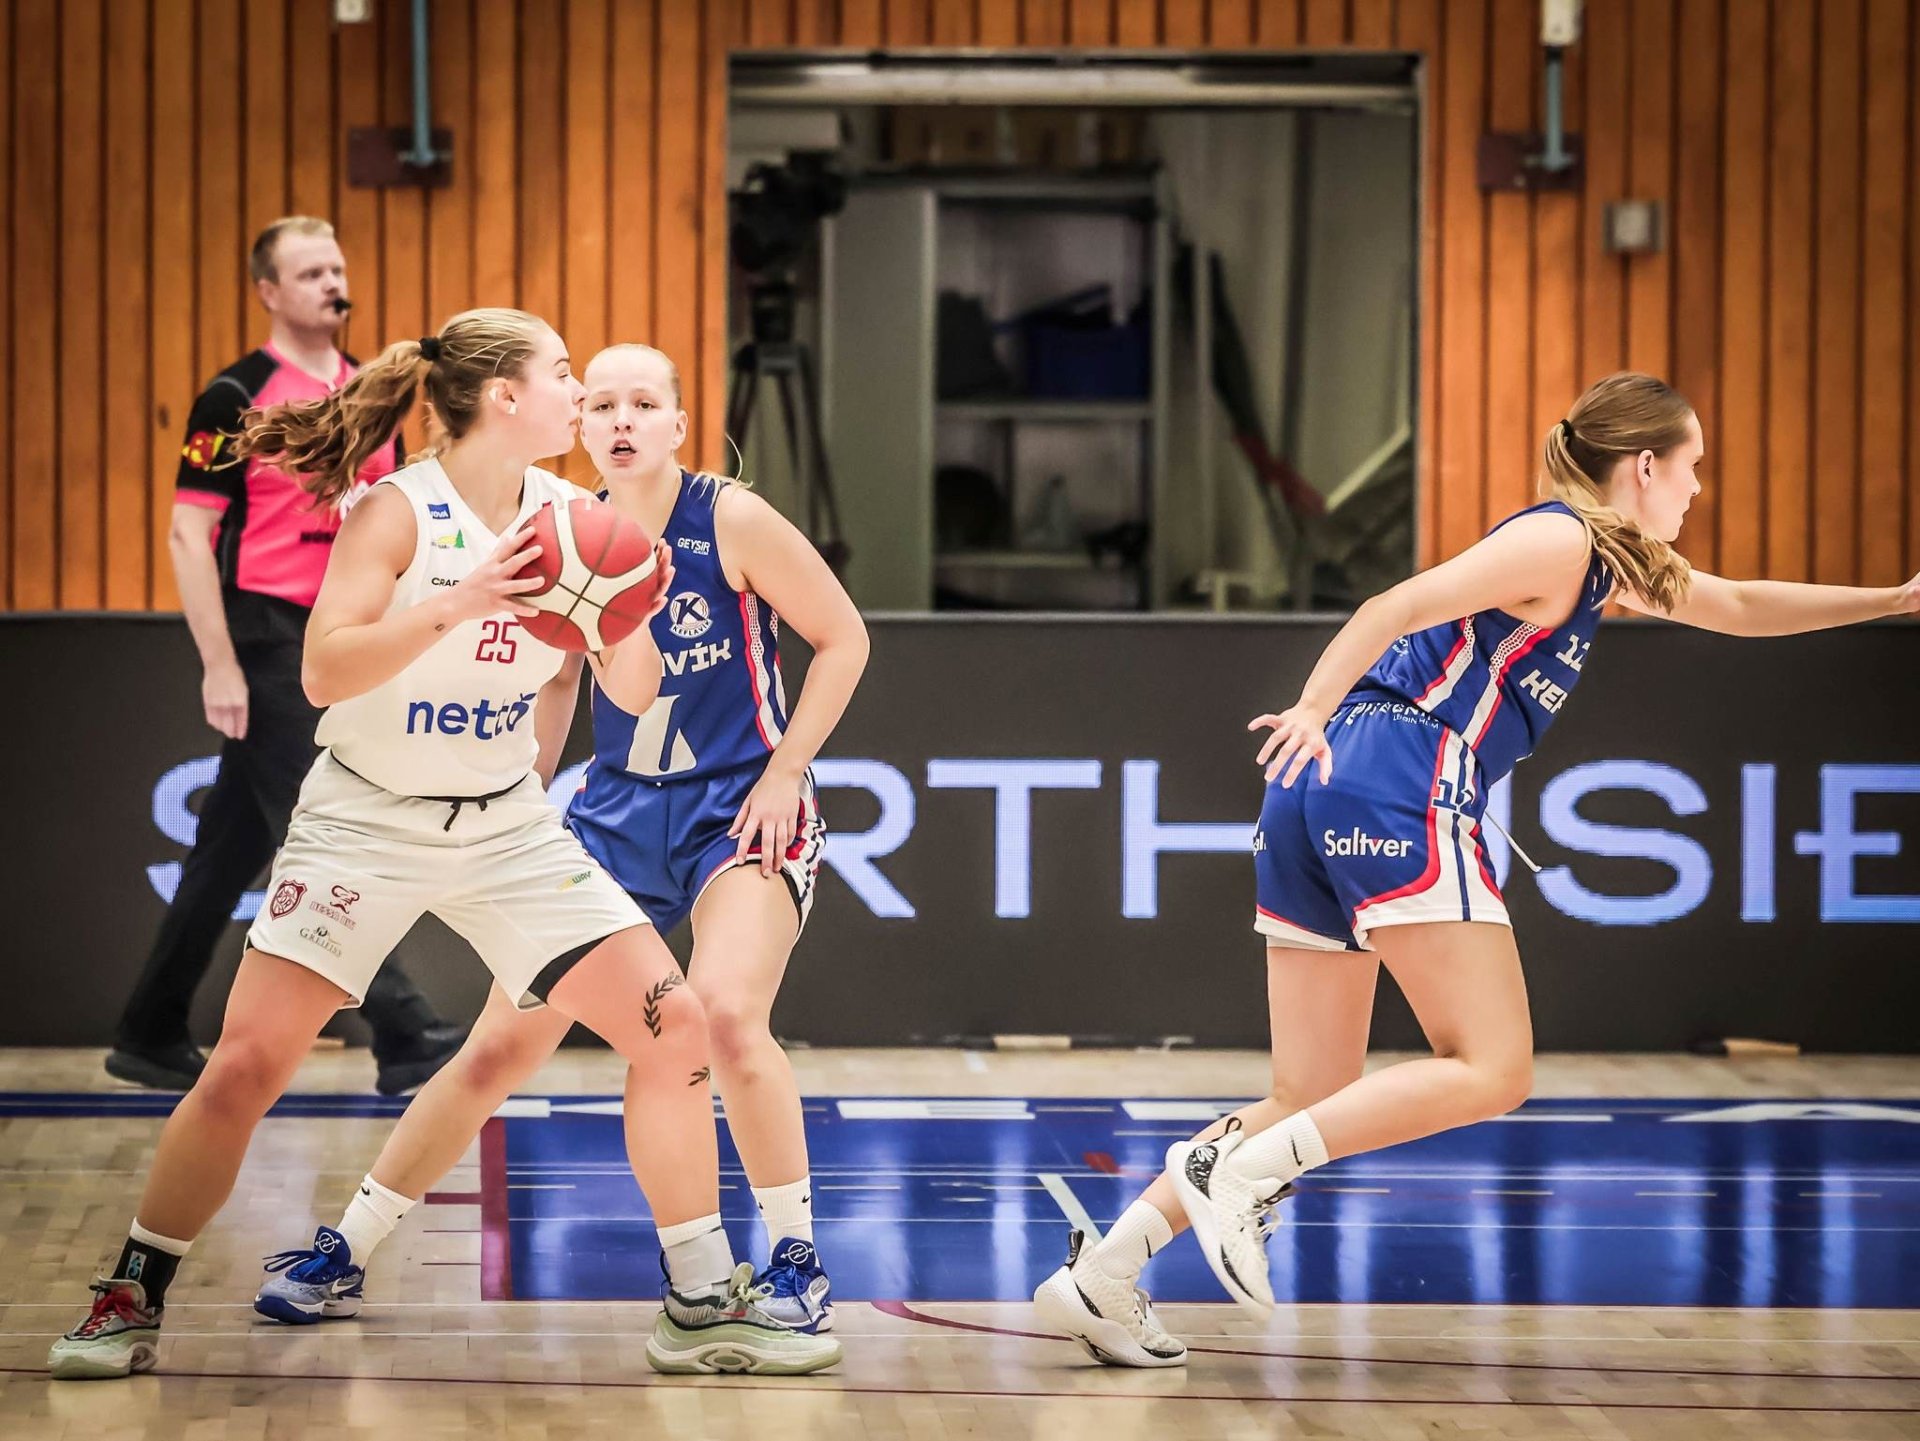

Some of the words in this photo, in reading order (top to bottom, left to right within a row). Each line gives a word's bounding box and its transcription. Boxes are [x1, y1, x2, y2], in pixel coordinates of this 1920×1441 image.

[677, 537, 711, 552] GEYSIR
[475, 620, 520, 664] 25
[1324, 827, 1413, 858] Saltver
